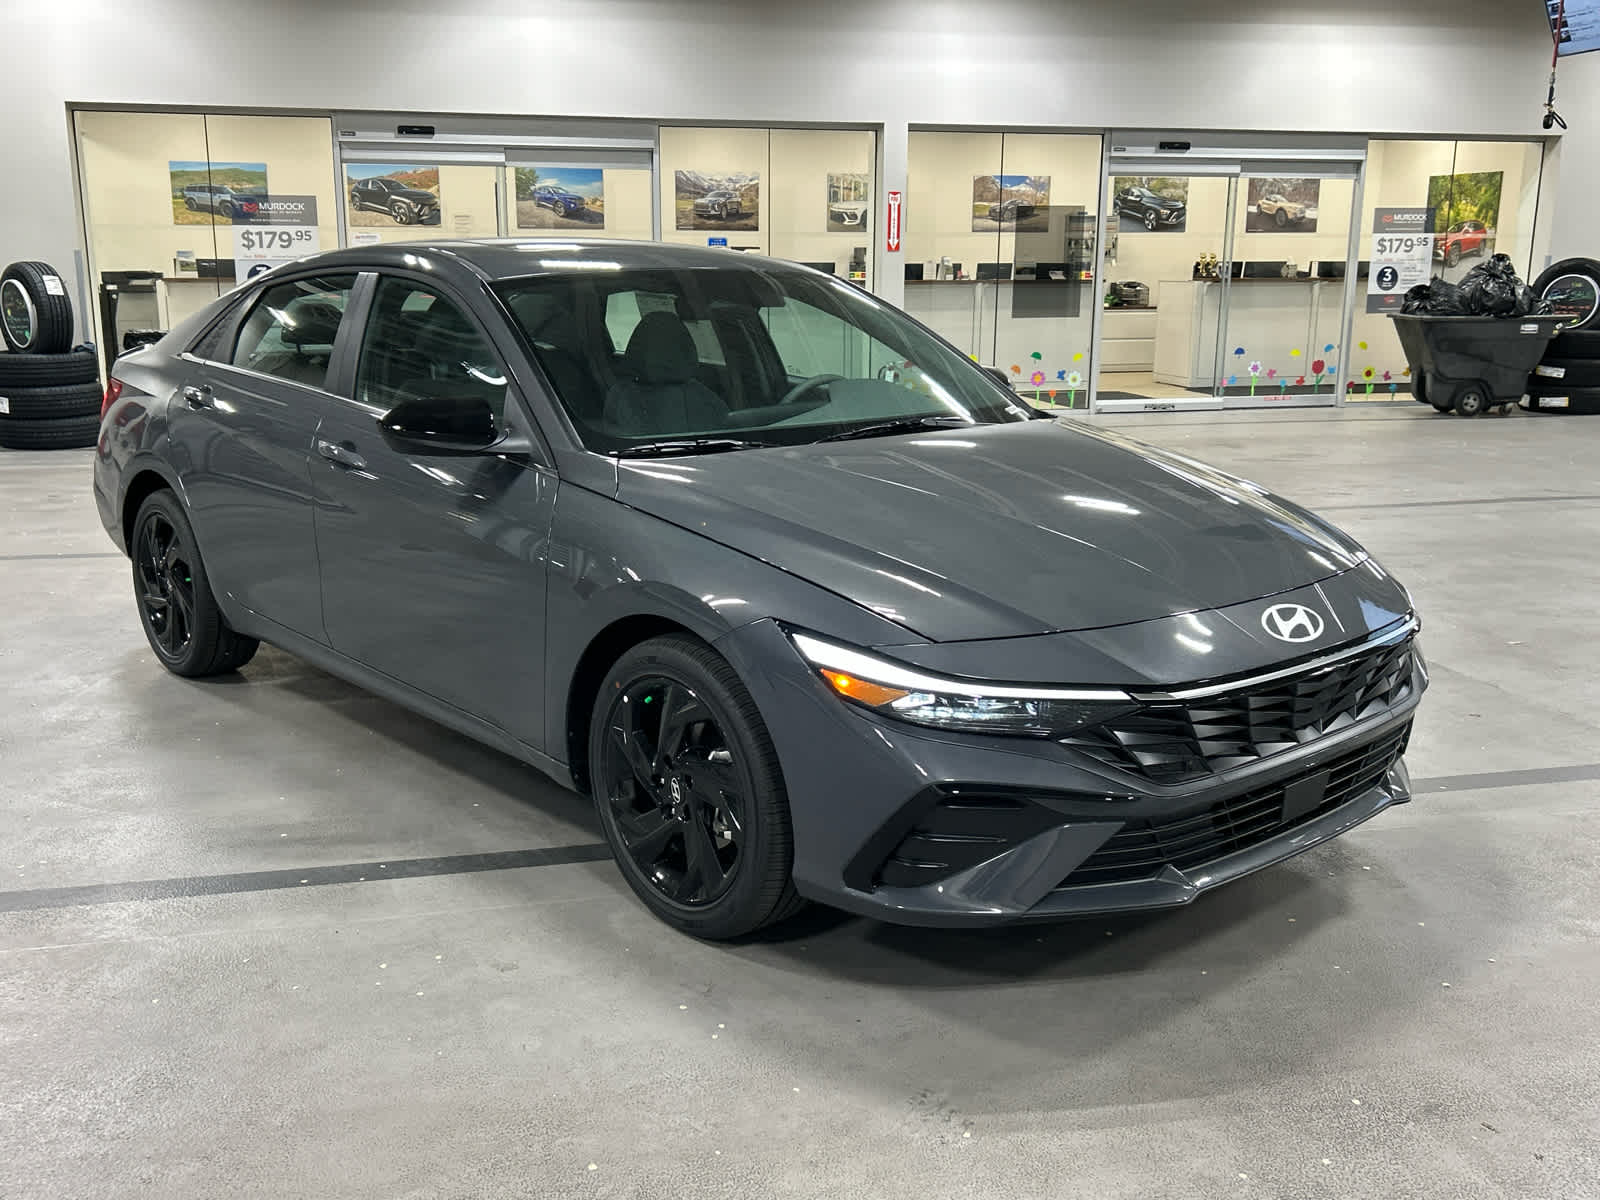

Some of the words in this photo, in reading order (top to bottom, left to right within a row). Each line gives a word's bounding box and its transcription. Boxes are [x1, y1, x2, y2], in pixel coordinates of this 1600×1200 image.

[258, 202, 305, 211] MURDOCK
[240, 229, 312, 251] $179.95
[1382, 268, 1393, 282] 3
